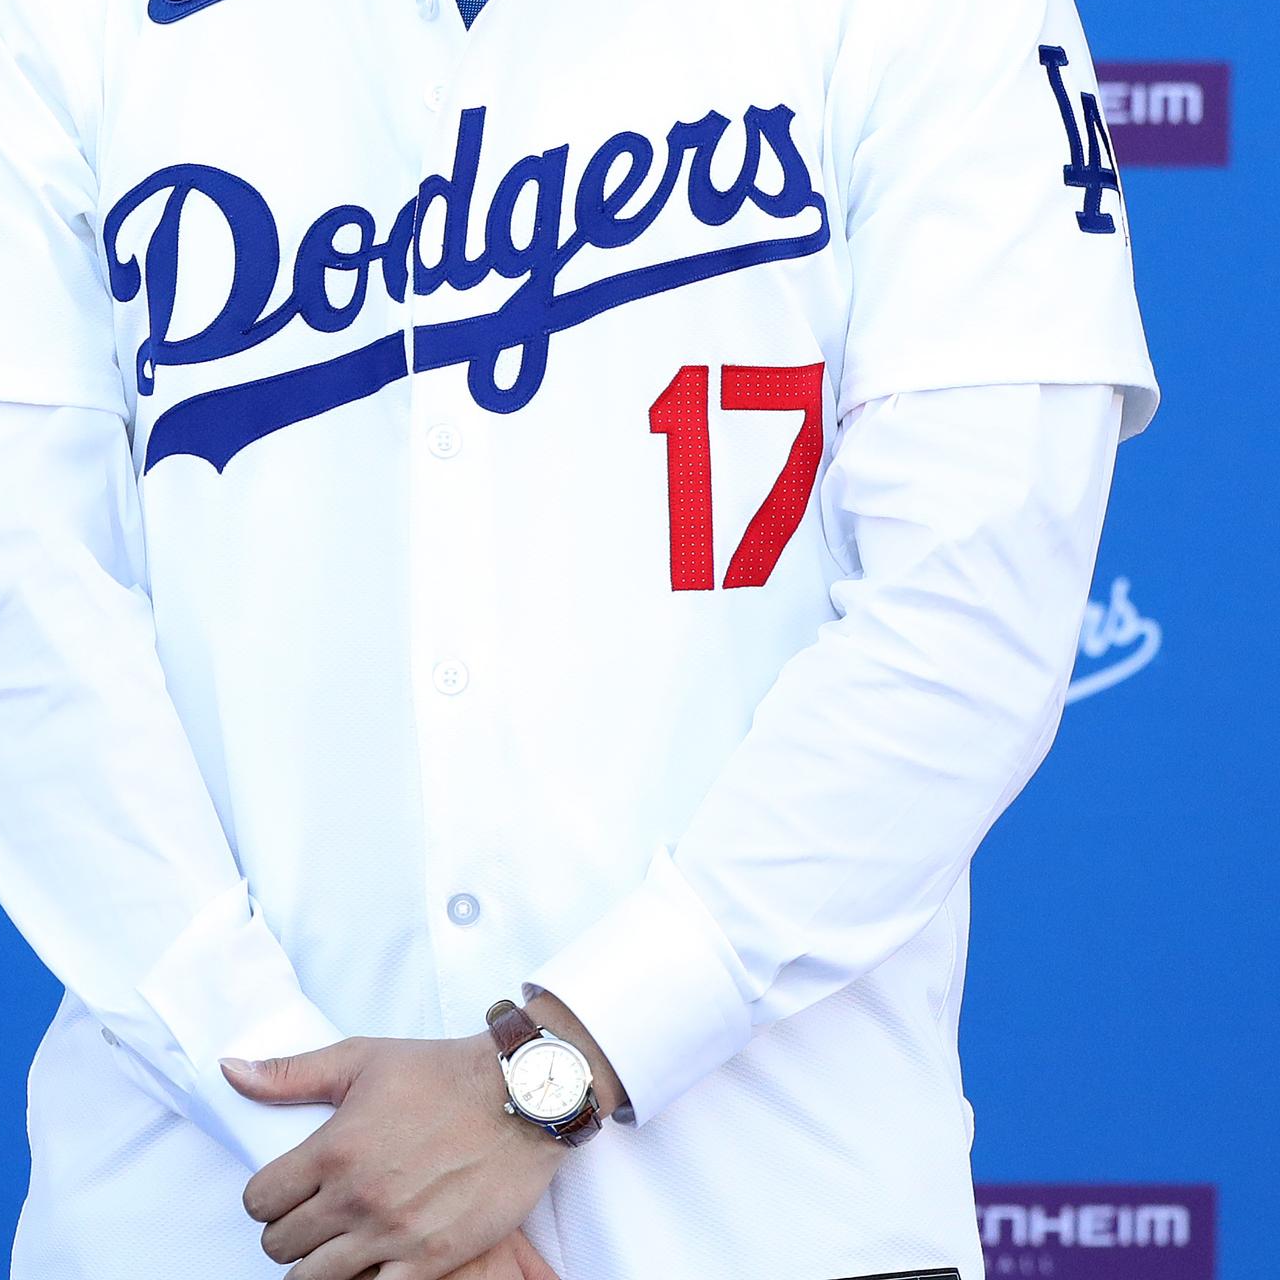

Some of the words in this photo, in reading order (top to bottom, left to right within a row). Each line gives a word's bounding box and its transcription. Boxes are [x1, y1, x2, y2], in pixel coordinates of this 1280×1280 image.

[104, 104, 829, 477] Dodgers
[649, 362, 826, 592] 17
[977, 1204, 1189, 1248] NHEIM
